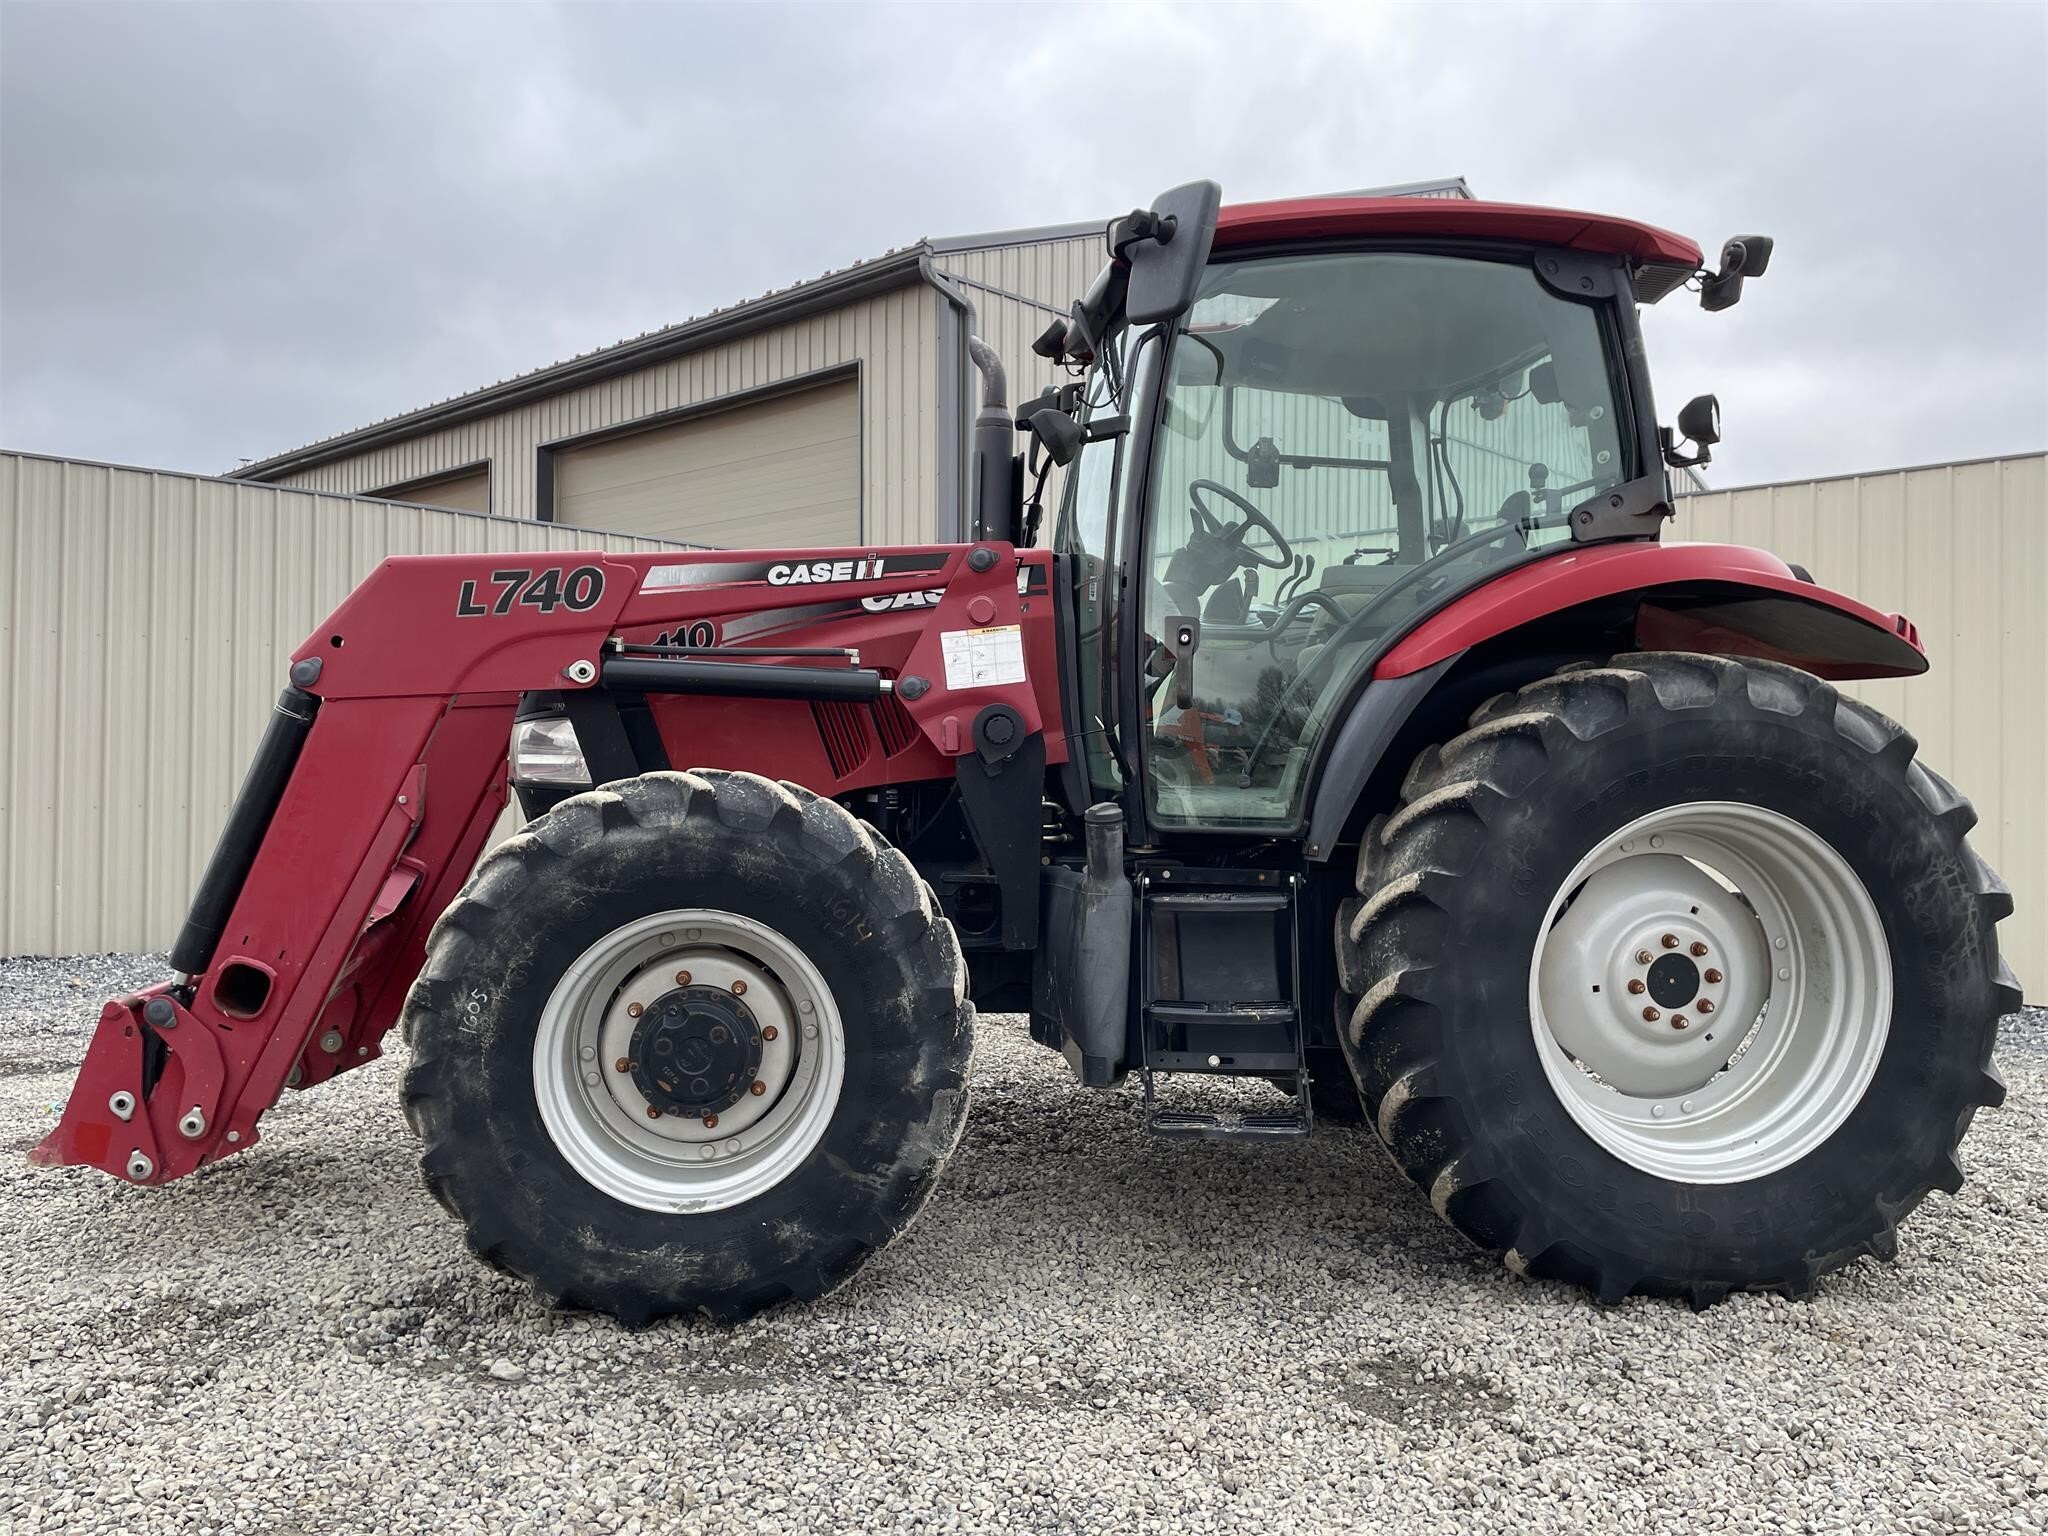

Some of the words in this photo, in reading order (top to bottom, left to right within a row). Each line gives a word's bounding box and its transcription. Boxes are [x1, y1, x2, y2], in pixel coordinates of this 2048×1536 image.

[456, 565, 606, 618] L740
[767, 561, 854, 586] CASE
[651, 619, 716, 660] 110
[458, 988, 488, 1034] 1605
